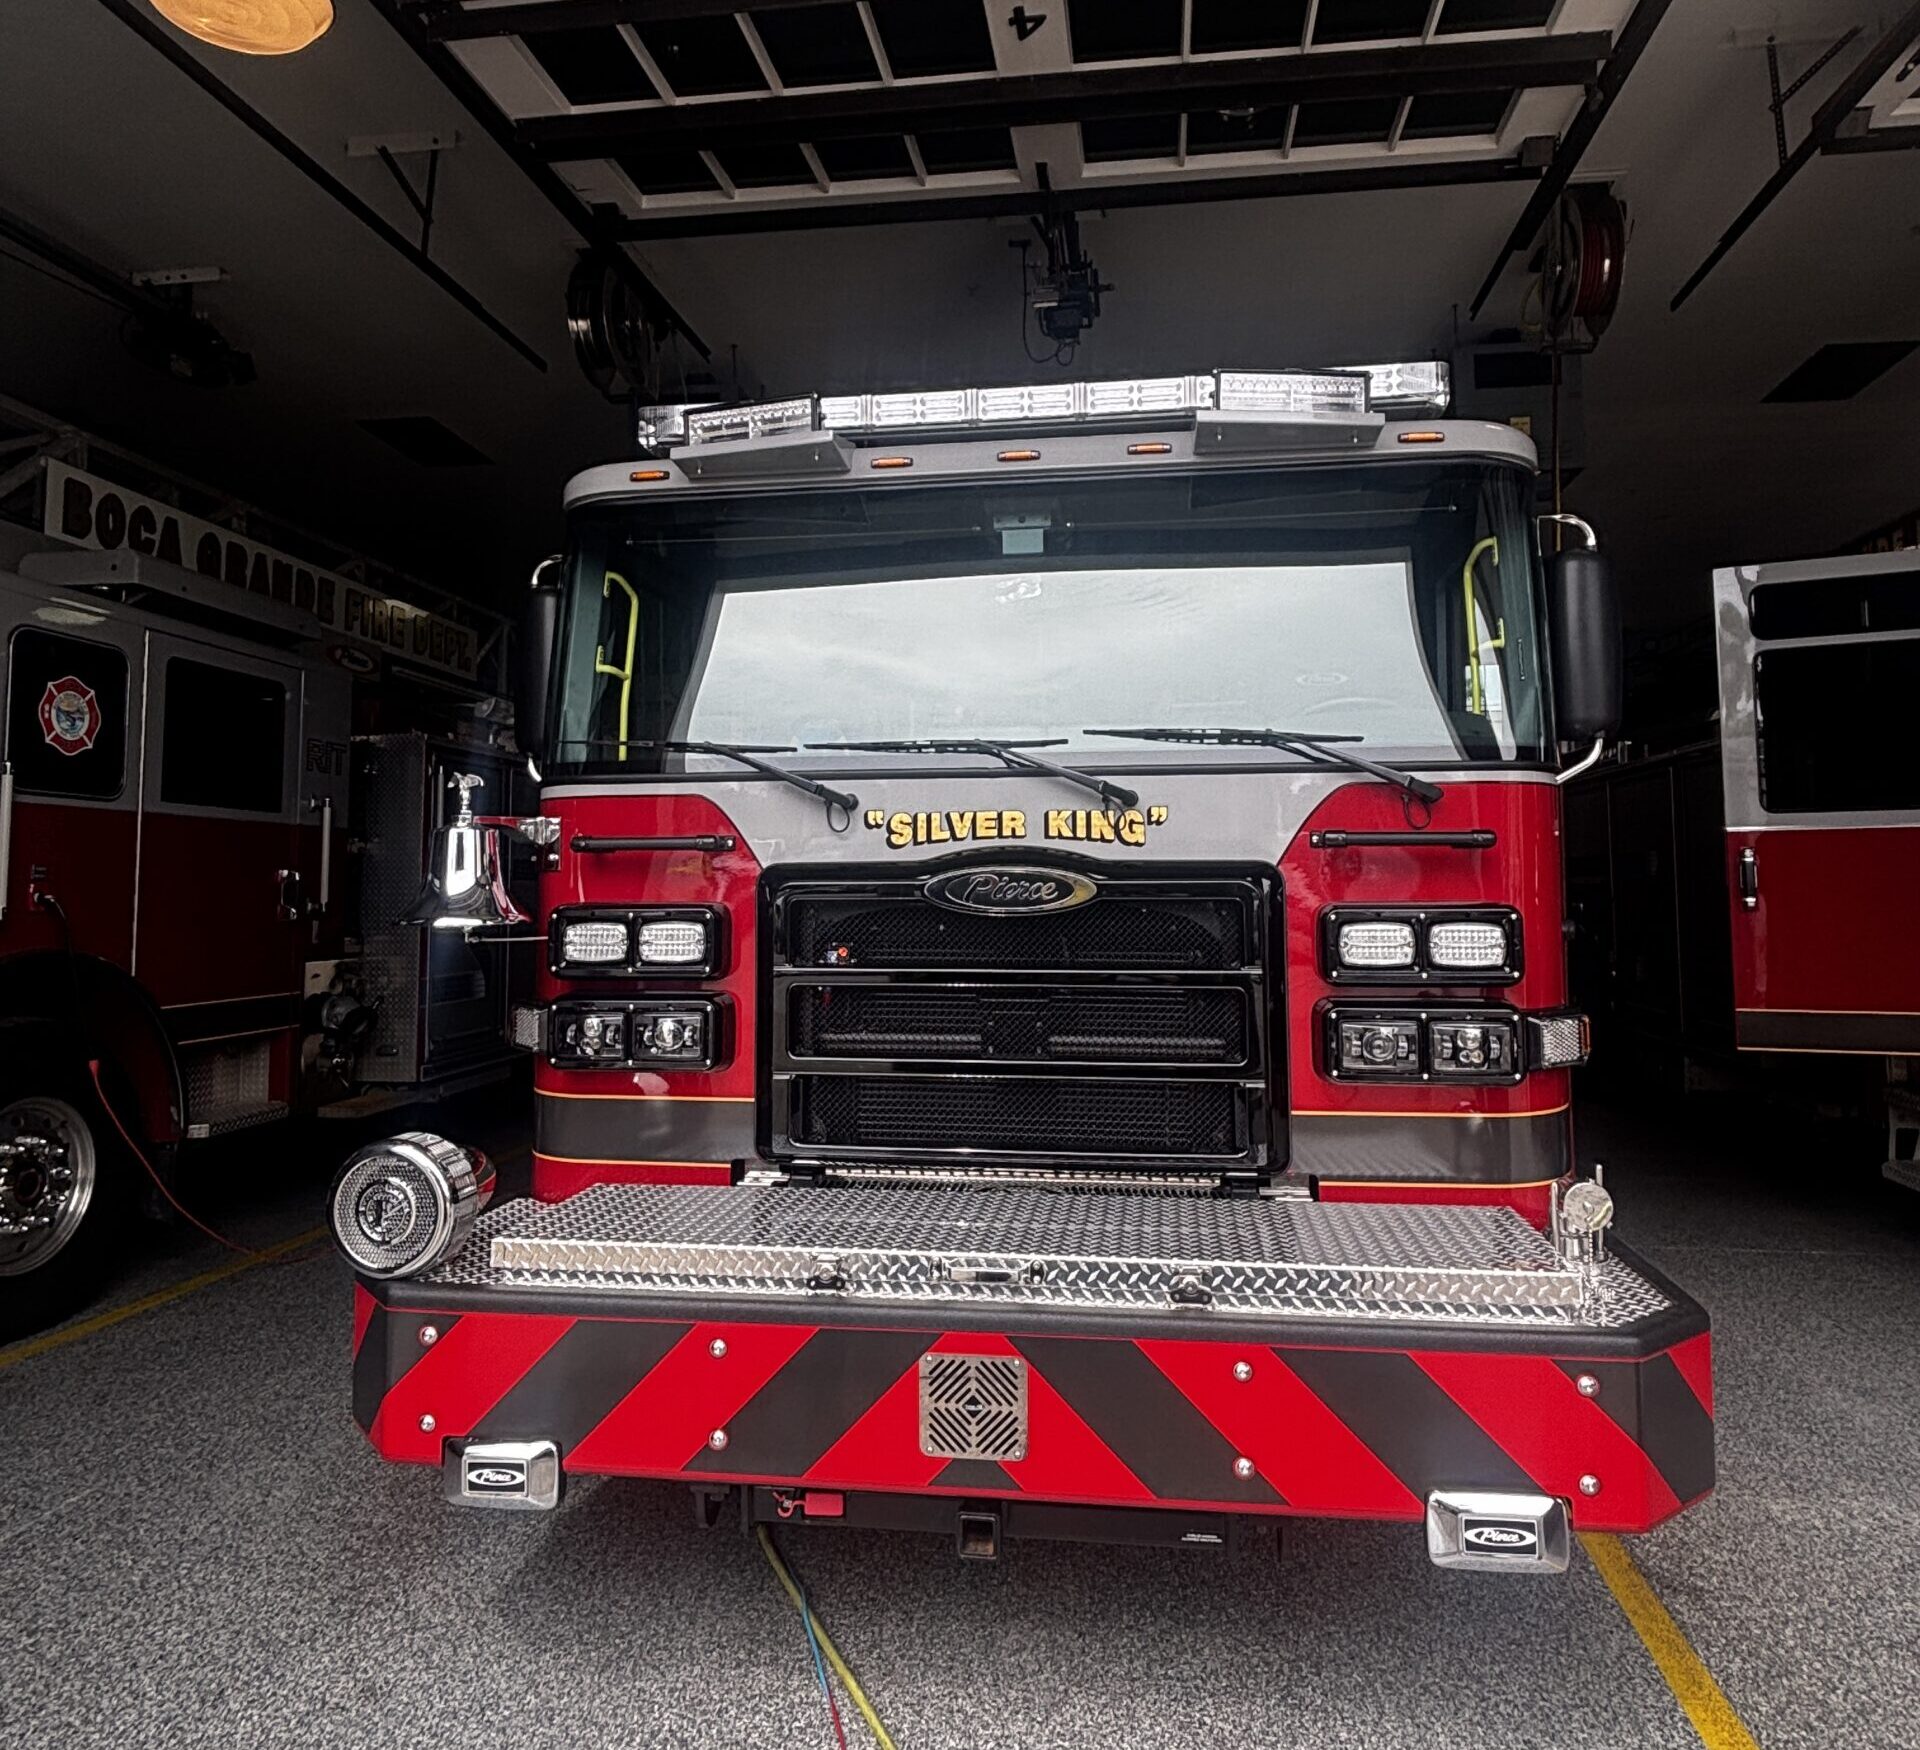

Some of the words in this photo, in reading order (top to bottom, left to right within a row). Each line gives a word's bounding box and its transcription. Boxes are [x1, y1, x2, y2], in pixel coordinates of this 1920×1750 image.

[1008, 6, 1047, 42] 4
[62, 477, 182, 566] BOCA
[345, 588, 404, 649] FIRE
[413, 614, 471, 672] DEPT.
[306, 738, 347, 776] RIT
[962, 873, 1059, 905] Pierce
